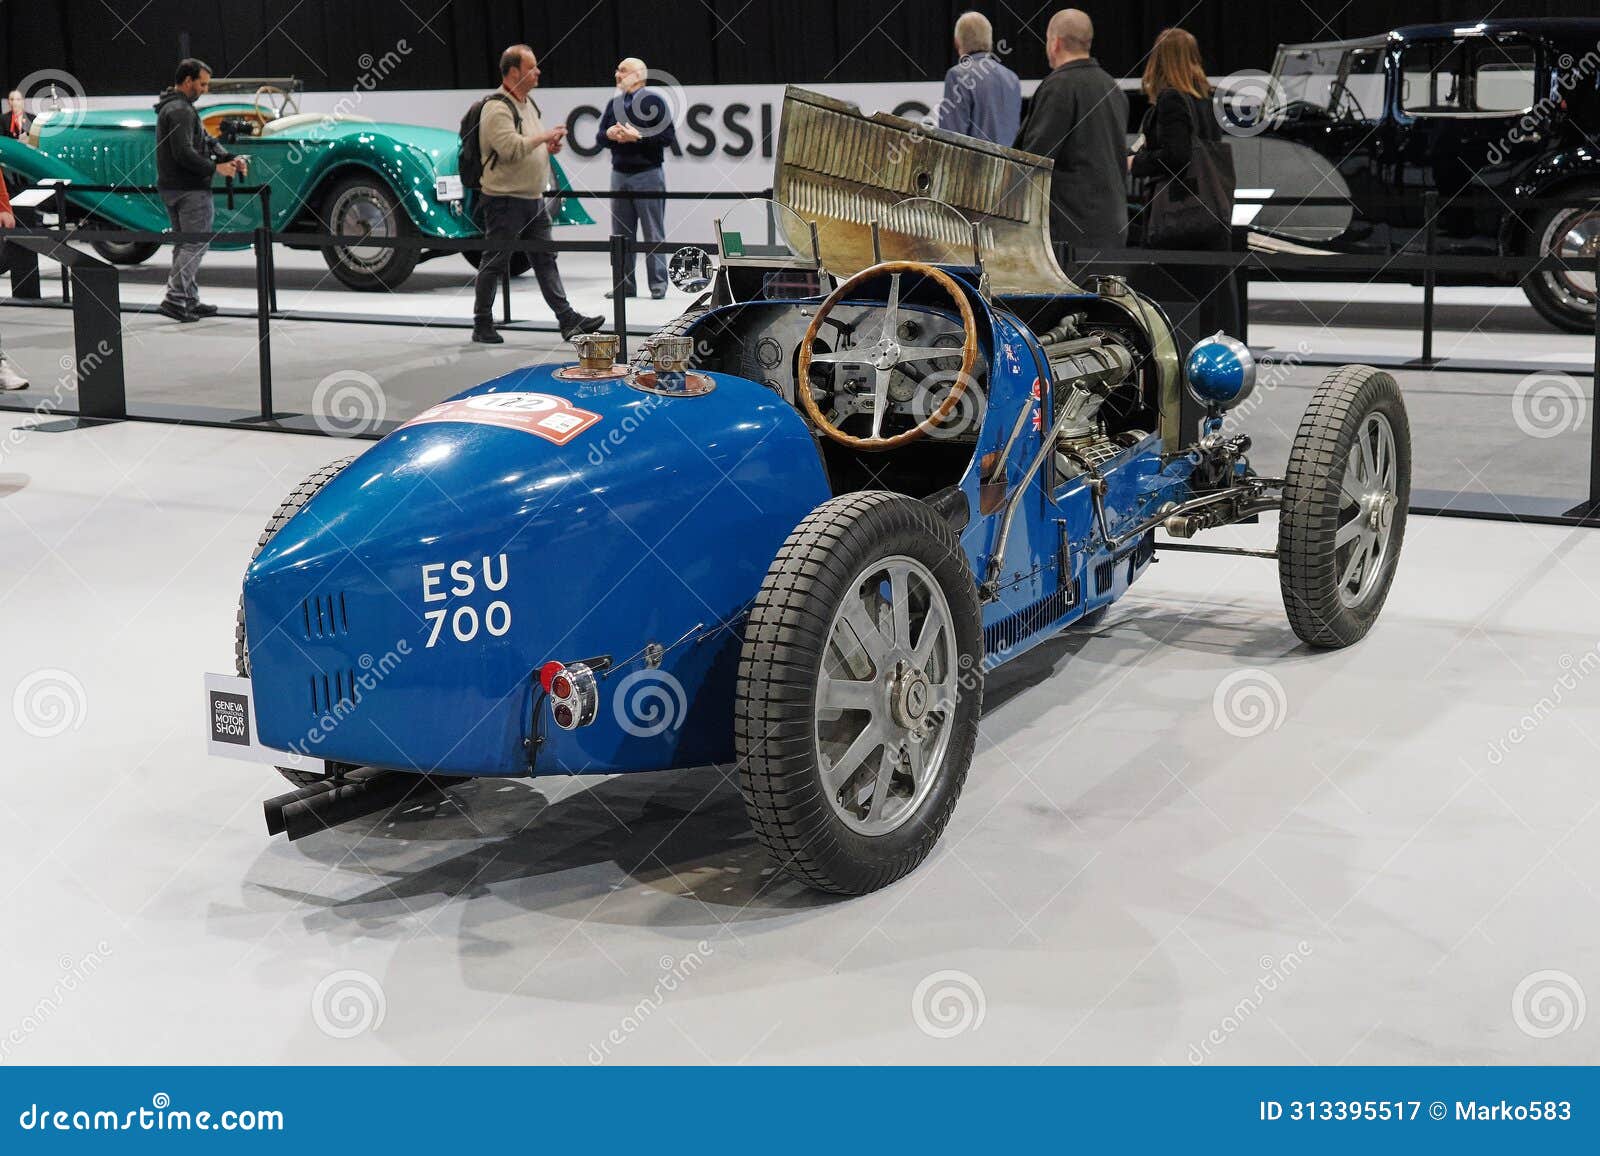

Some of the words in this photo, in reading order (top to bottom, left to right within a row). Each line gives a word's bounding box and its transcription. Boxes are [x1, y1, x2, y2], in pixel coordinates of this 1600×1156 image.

[566, 102, 773, 158] CSSI
[422, 553, 508, 602] ESU
[424, 600, 511, 648] 700
[214, 700, 244, 713] GENEVA
[215, 714, 245, 726] MOTOR
[216, 723, 245, 737] SHOW
